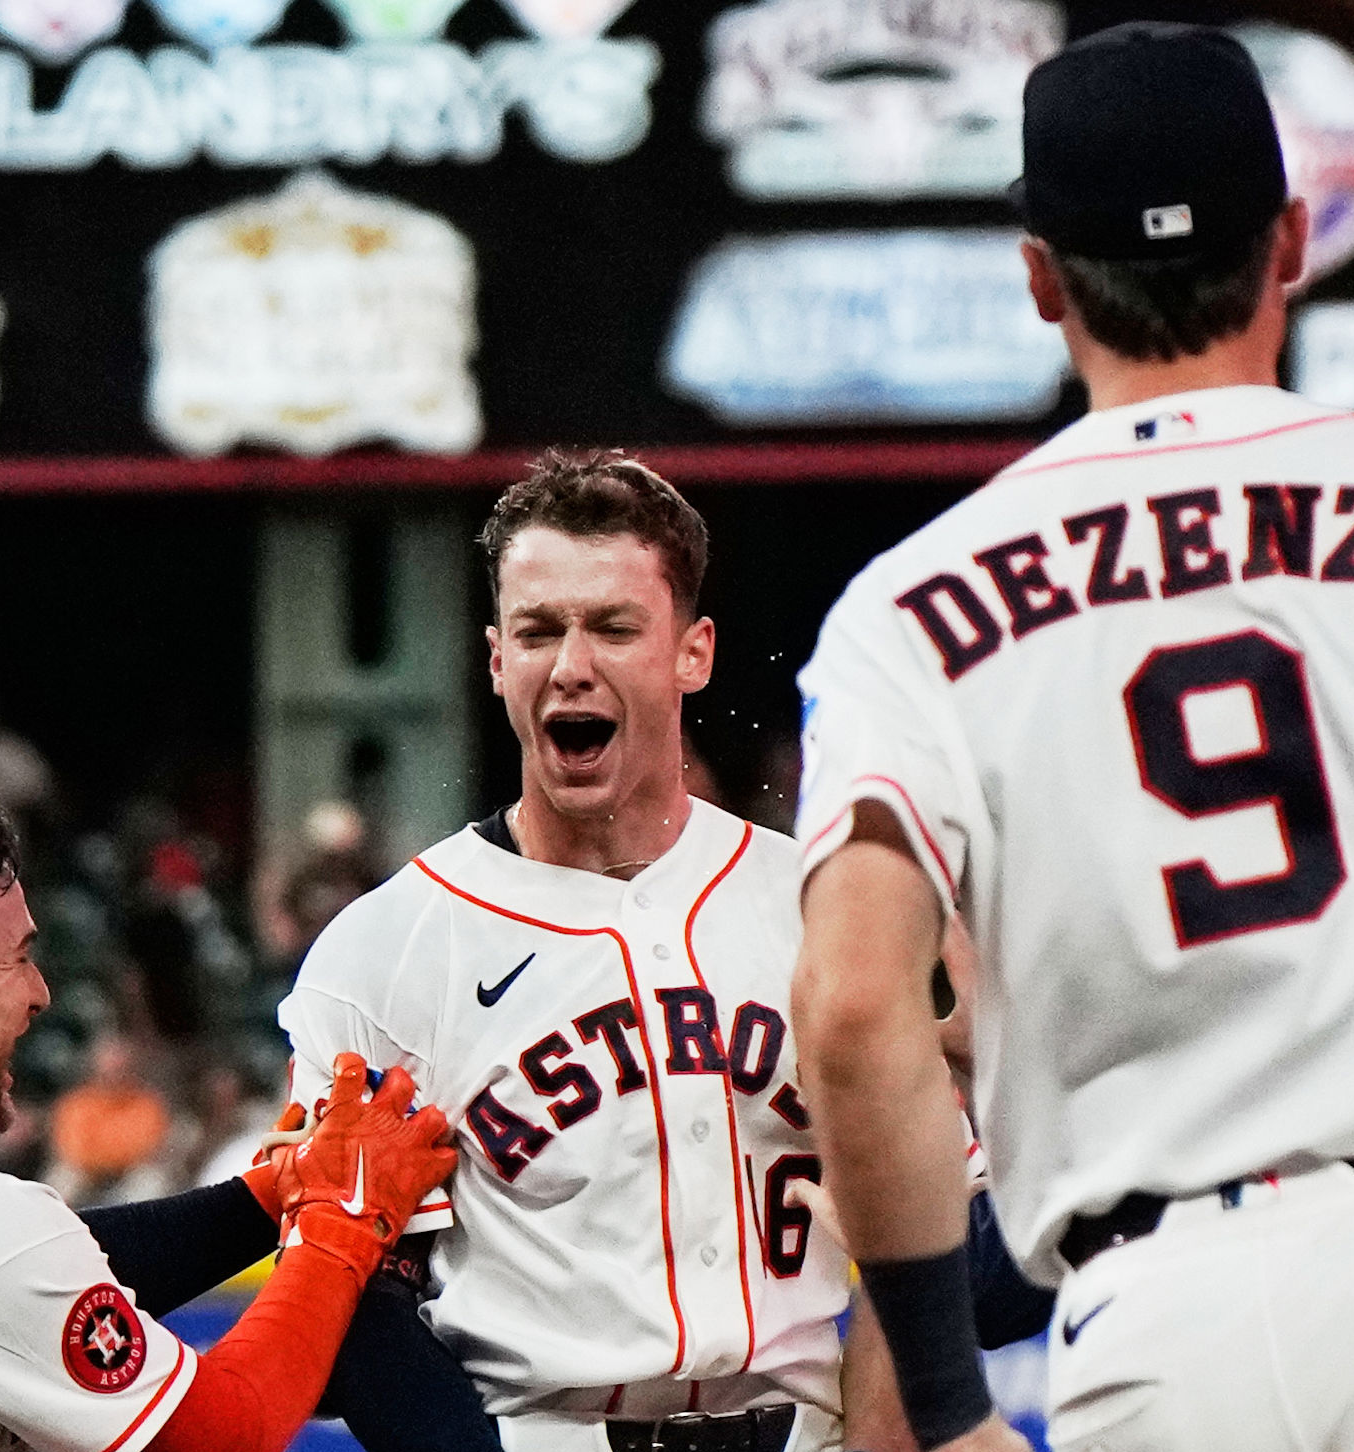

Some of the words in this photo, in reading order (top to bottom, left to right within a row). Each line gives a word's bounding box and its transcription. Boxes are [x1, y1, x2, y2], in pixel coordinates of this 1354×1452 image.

[1122, 627, 1349, 950] 9
[746, 1154, 821, 1279] 6
[100, 1336, 142, 1385] ASTROS
